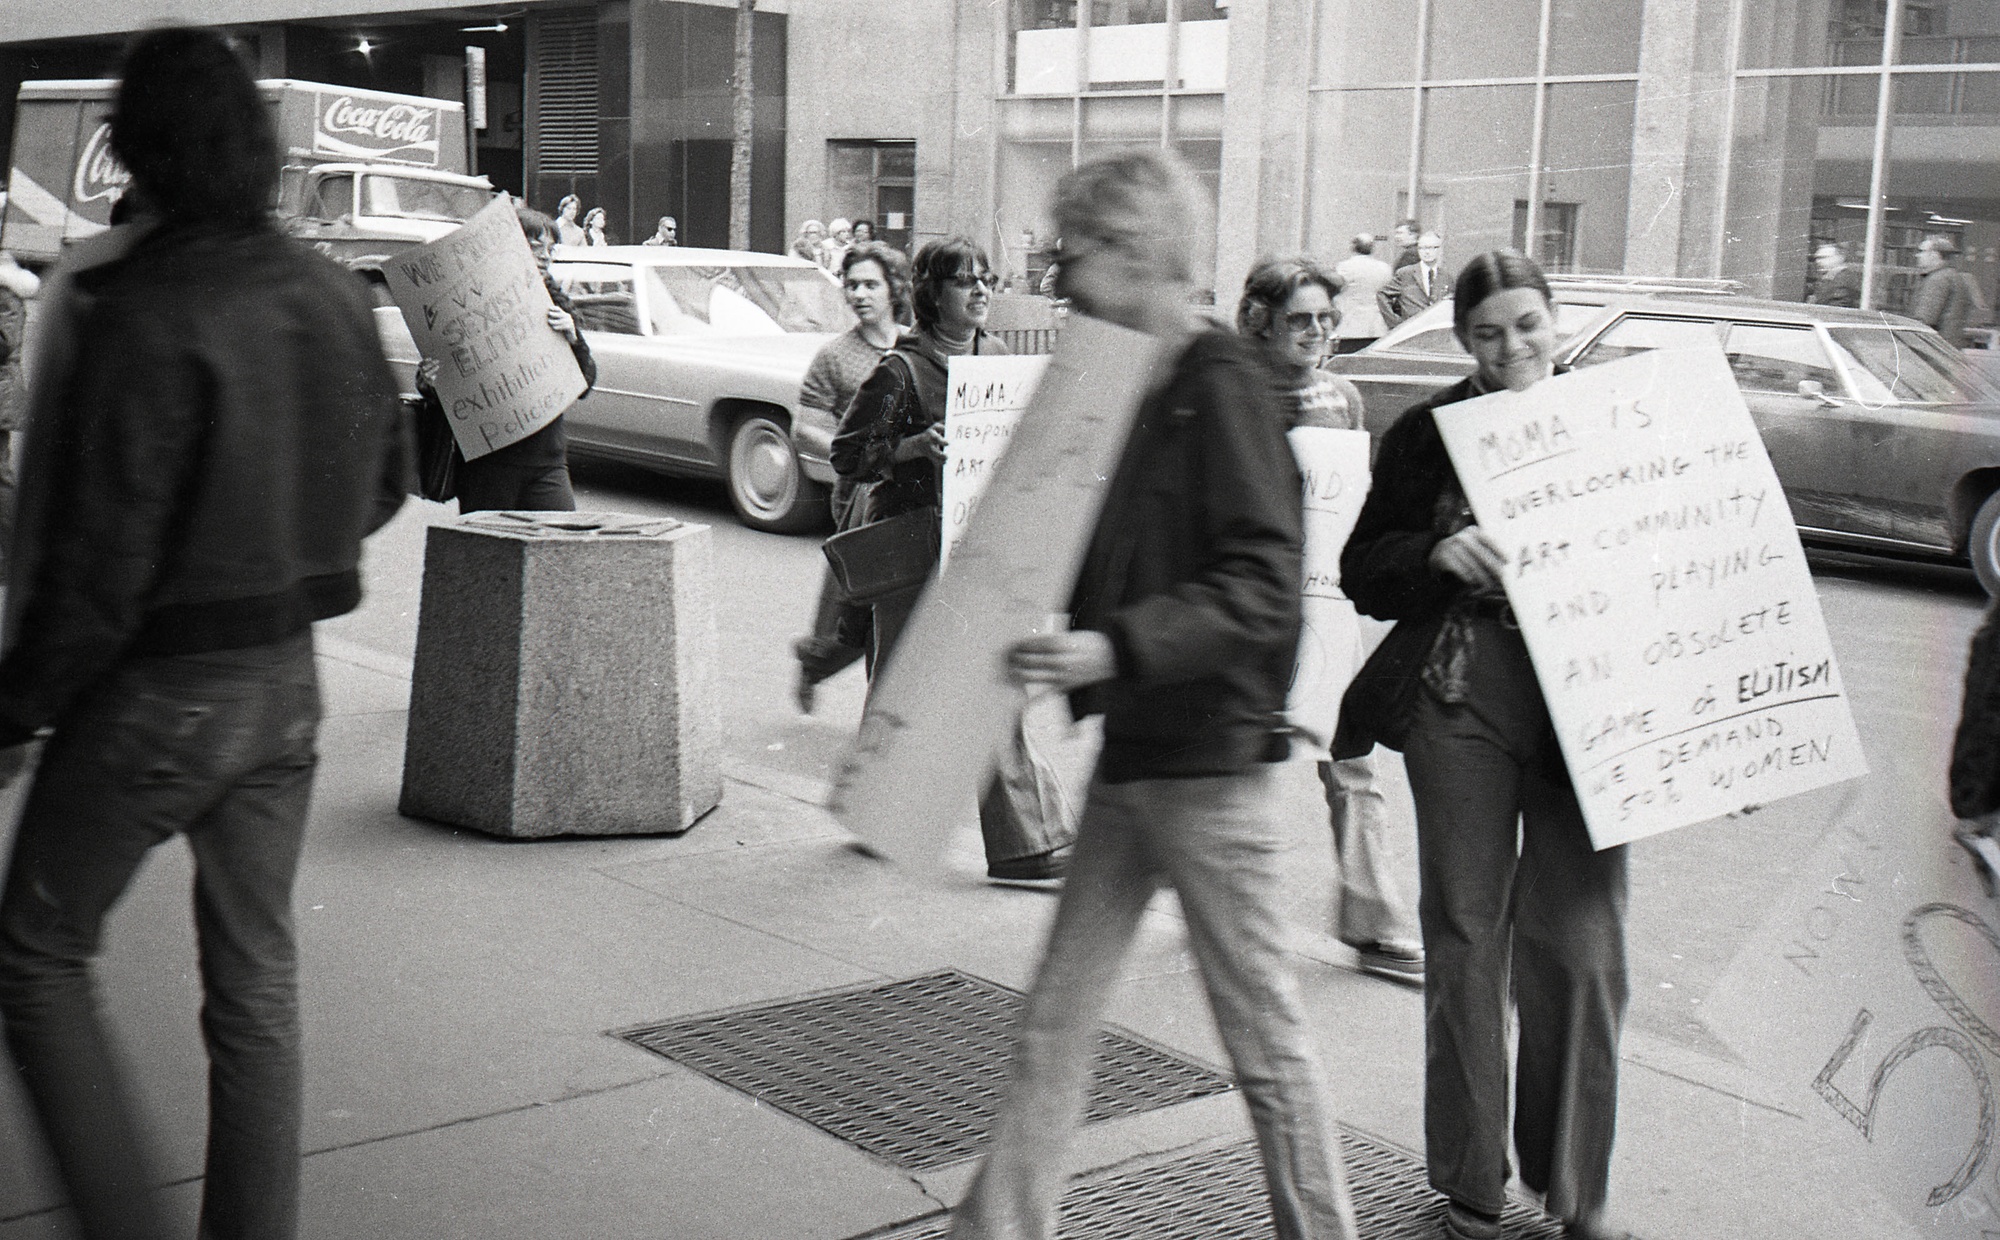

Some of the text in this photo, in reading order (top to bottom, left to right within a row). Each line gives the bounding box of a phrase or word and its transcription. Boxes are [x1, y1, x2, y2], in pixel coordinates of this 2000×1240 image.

[325, 97, 433, 142] Coca-Cola
[400, 252, 446, 288] WE
[442, 275, 524, 347] SEXIST
[452, 352, 555, 421] exhibition
[955, 458, 984, 477] ART
[1477, 389, 1653, 472] MOMA IS
[1500, 440, 1751, 520] OVERLOOKING THE
[1517, 489, 1768, 580] ART COMMUNITY
[1546, 545, 1785, 624] AND PLAYING
[1563, 600, 1793, 693] AN OBSOLETE
[1582, 708, 1657, 752] GAME
[1738, 651, 1833, 704] ELITISM
[1590, 716, 1785, 797] WE DEMAND
[1710, 735, 1834, 791] WOMEN
